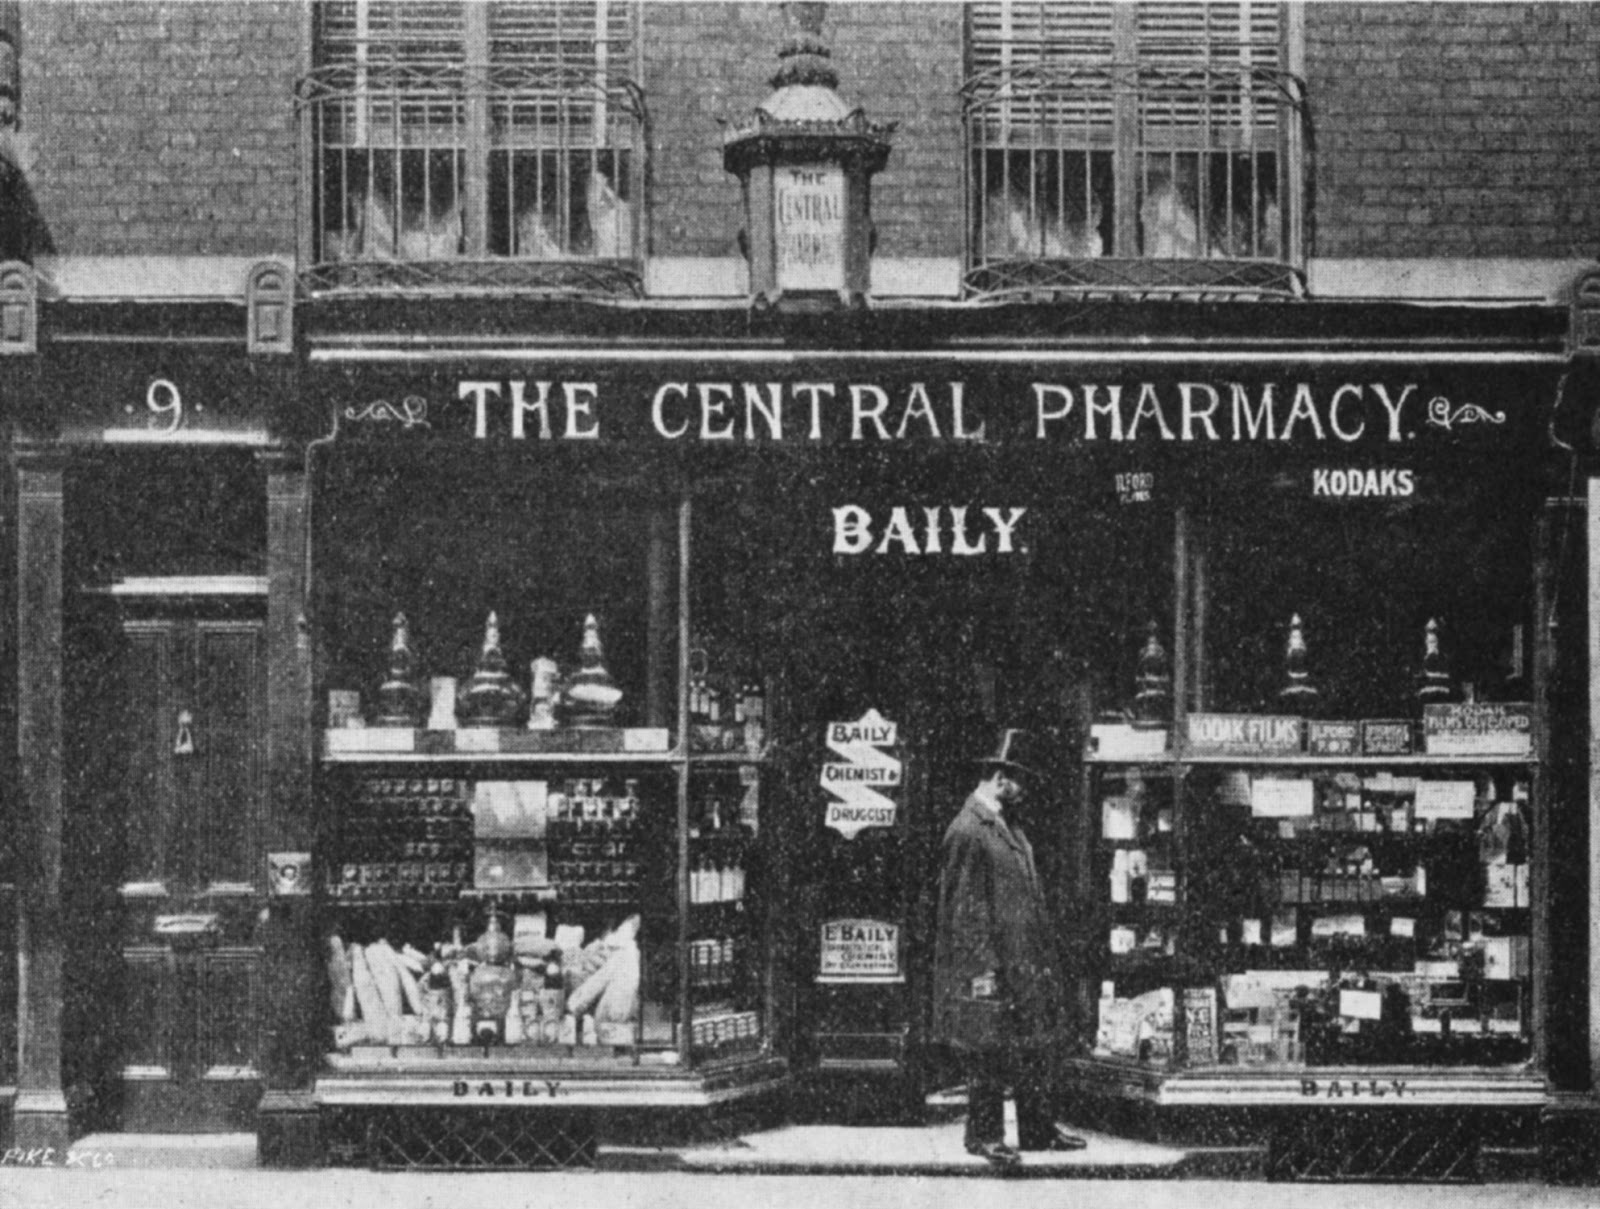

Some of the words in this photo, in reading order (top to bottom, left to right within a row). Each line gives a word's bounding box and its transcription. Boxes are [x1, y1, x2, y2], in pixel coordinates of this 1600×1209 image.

[458, 381, 599, 440] THE
[651, 381, 987, 440] CENTRAL
[1313, 469, 1415, 497] KODAKS
[832, 724, 893, 743] BAILY
[1189, 717, 1244, 742] KODAK
[1247, 719, 1299, 744] FILMS
[826, 765, 886, 782] CHEMIST
[841, 925, 895, 941] BAILY
